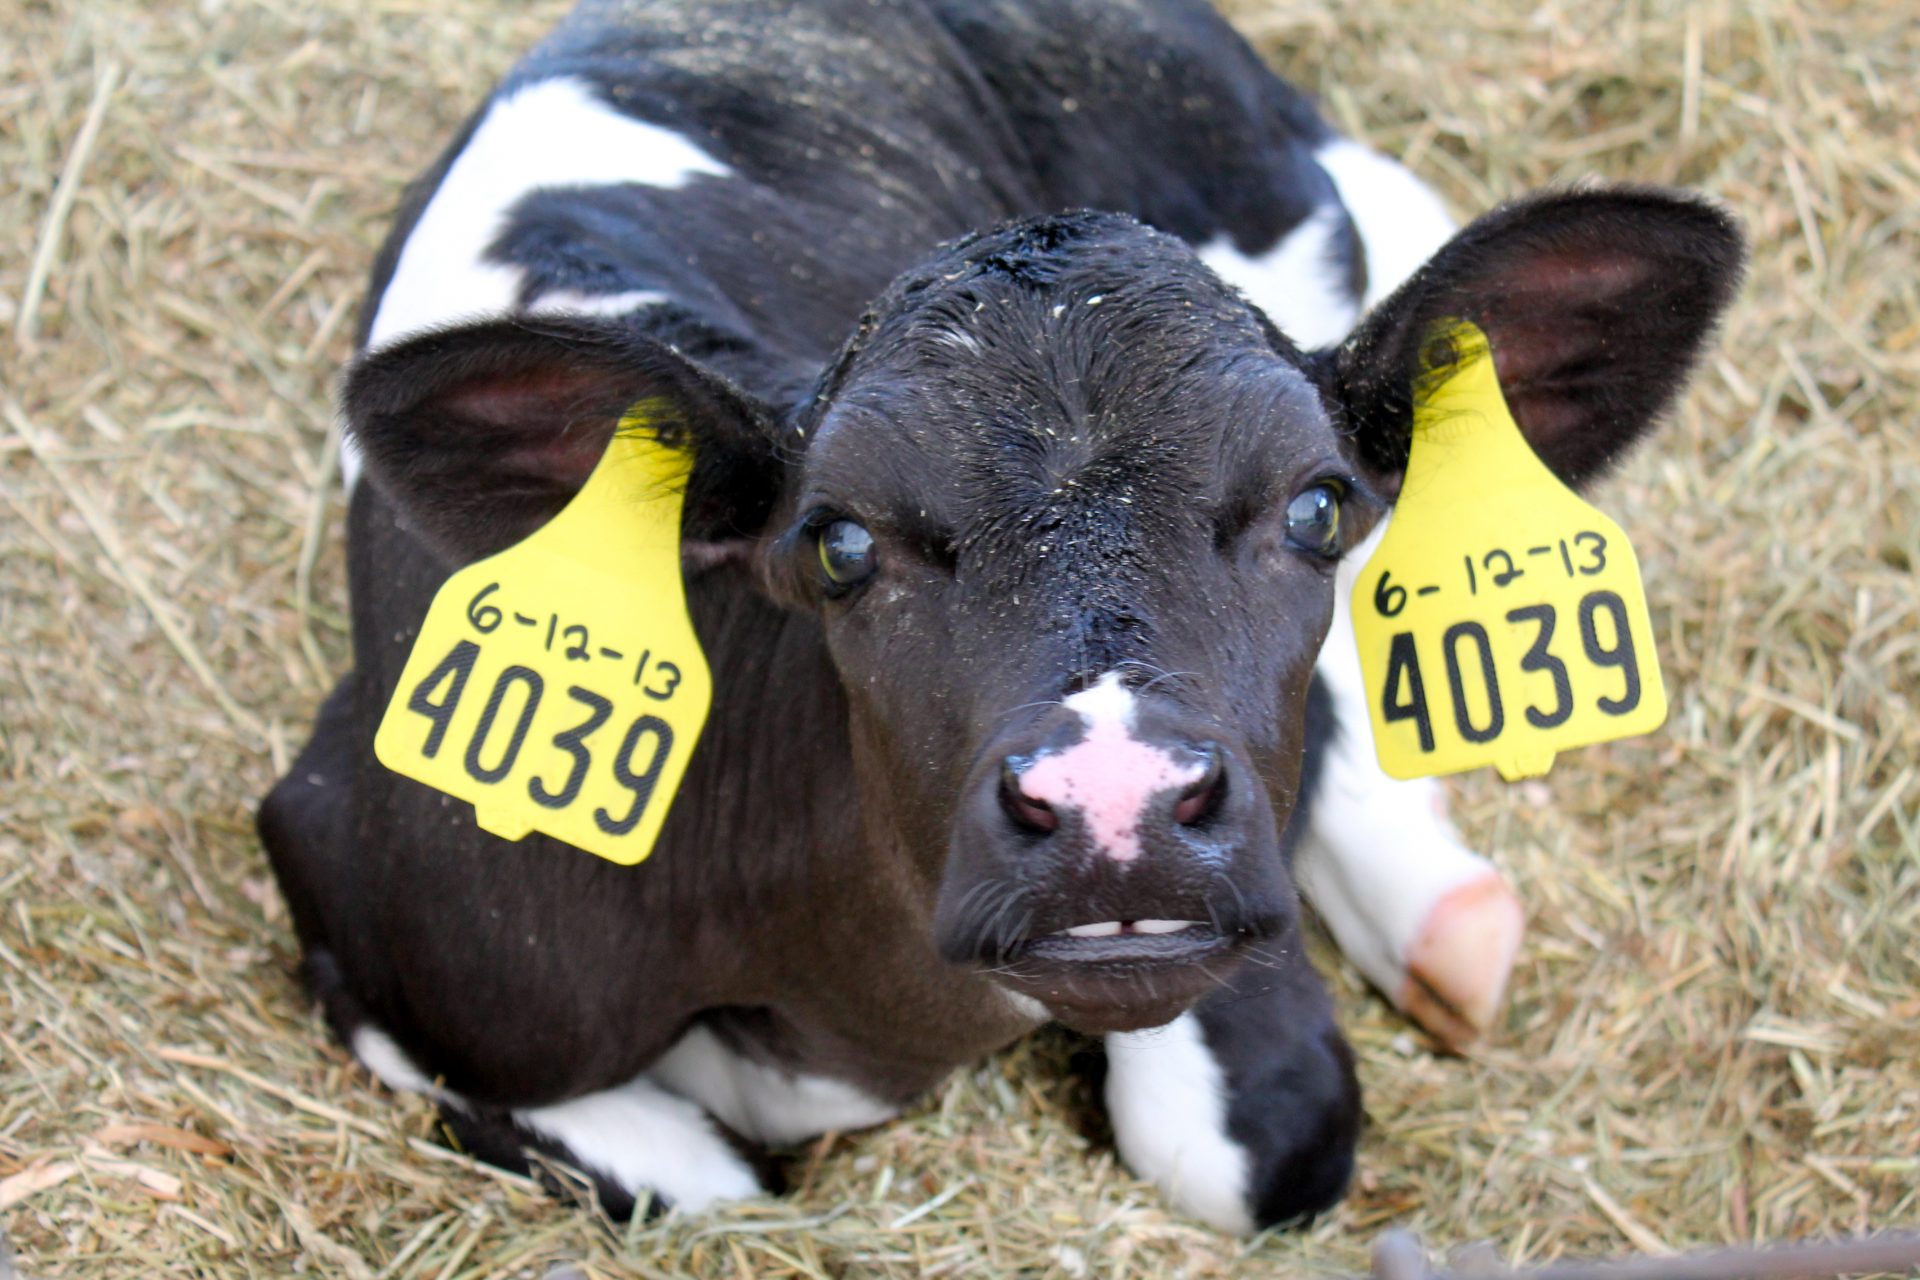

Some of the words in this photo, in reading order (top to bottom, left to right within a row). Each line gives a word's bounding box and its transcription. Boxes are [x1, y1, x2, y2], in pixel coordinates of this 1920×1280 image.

[466, 581, 682, 702] 6-12-13
[1372, 530, 1608, 619] 6-12-13
[407, 638, 675, 837] 4039
[1380, 589, 1642, 754] 4039
